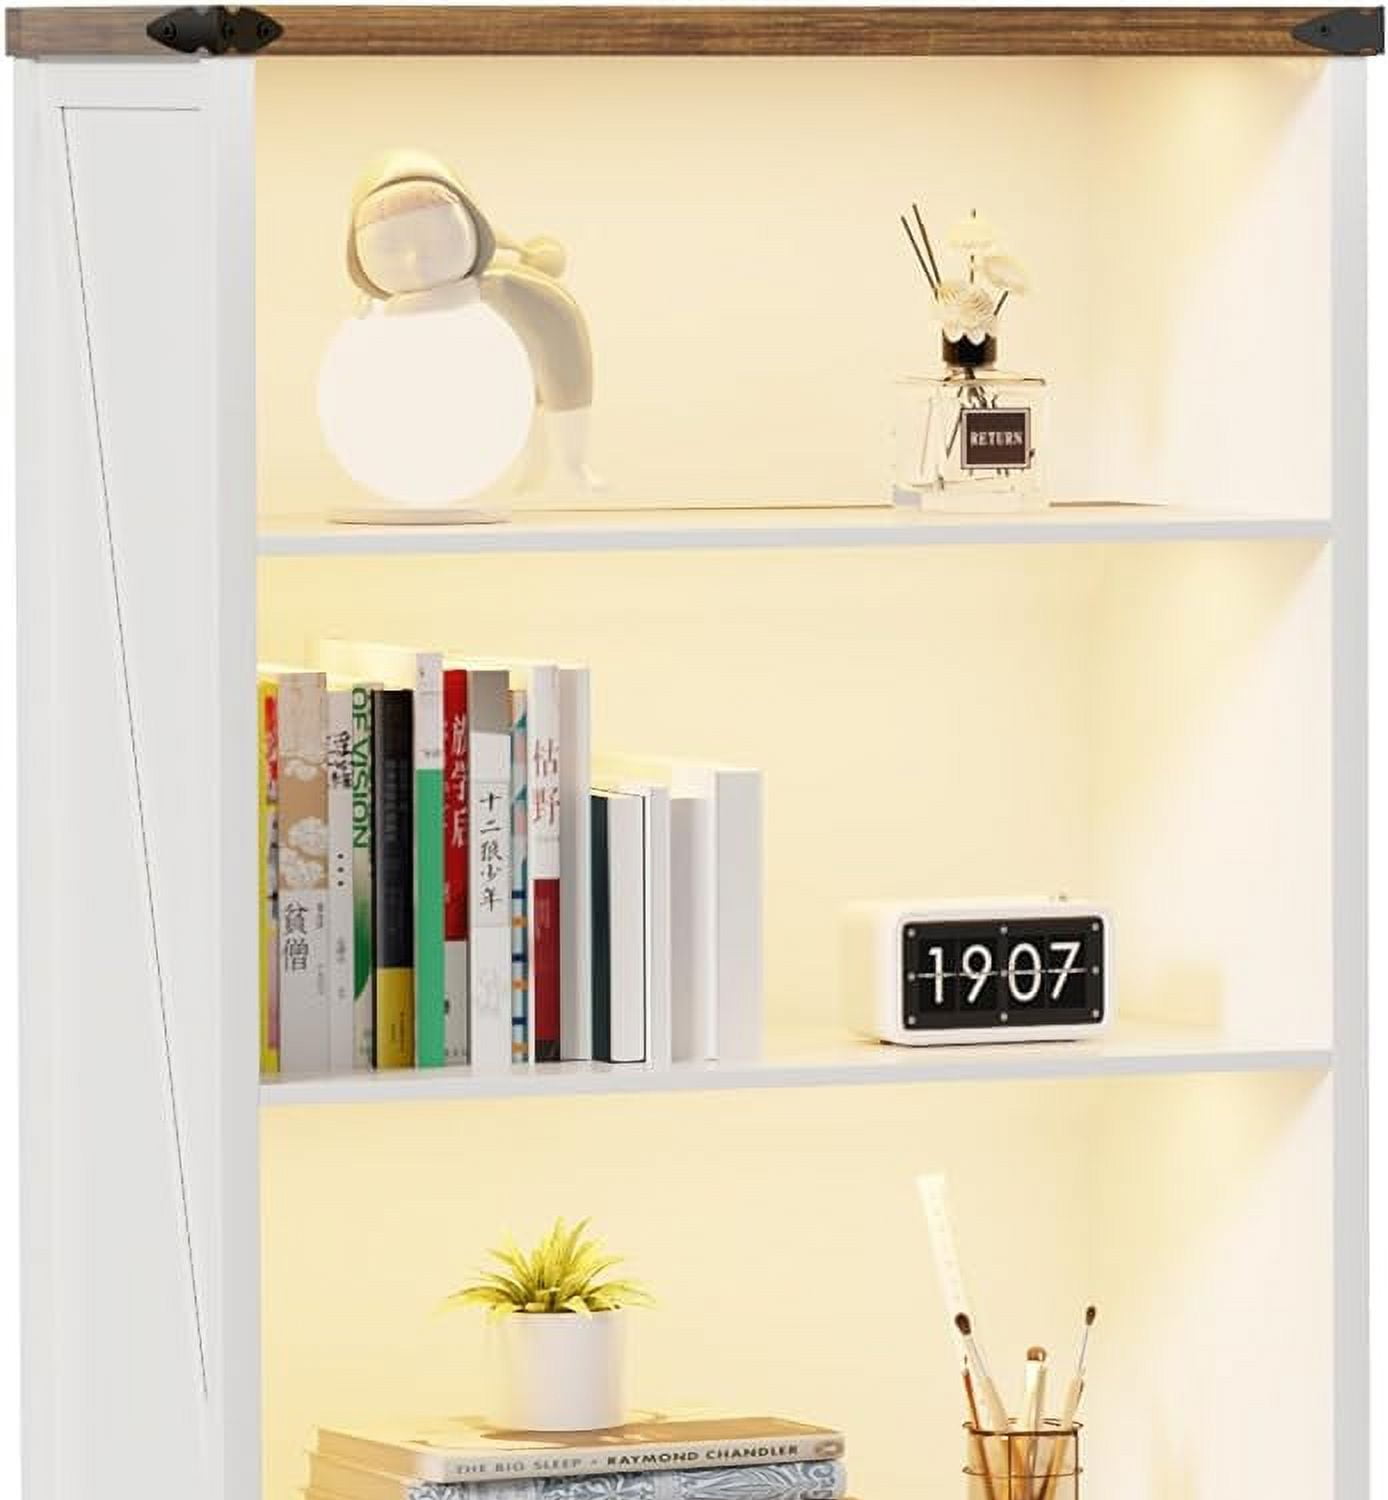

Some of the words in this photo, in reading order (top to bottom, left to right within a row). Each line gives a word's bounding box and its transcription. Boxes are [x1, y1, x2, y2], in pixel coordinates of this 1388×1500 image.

[970, 431, 1023, 446] RETURN
[351, 687, 367, 732] OF
[351, 738, 368, 848] VISION
[928, 941, 1081, 1004] 1907
[456, 1463, 486, 1475] THE
[533, 1457, 582, 1469] SLEEP
[607, 1451, 699, 1466] RAYMOND
[705, 1445, 798, 1460] CHANDLER
